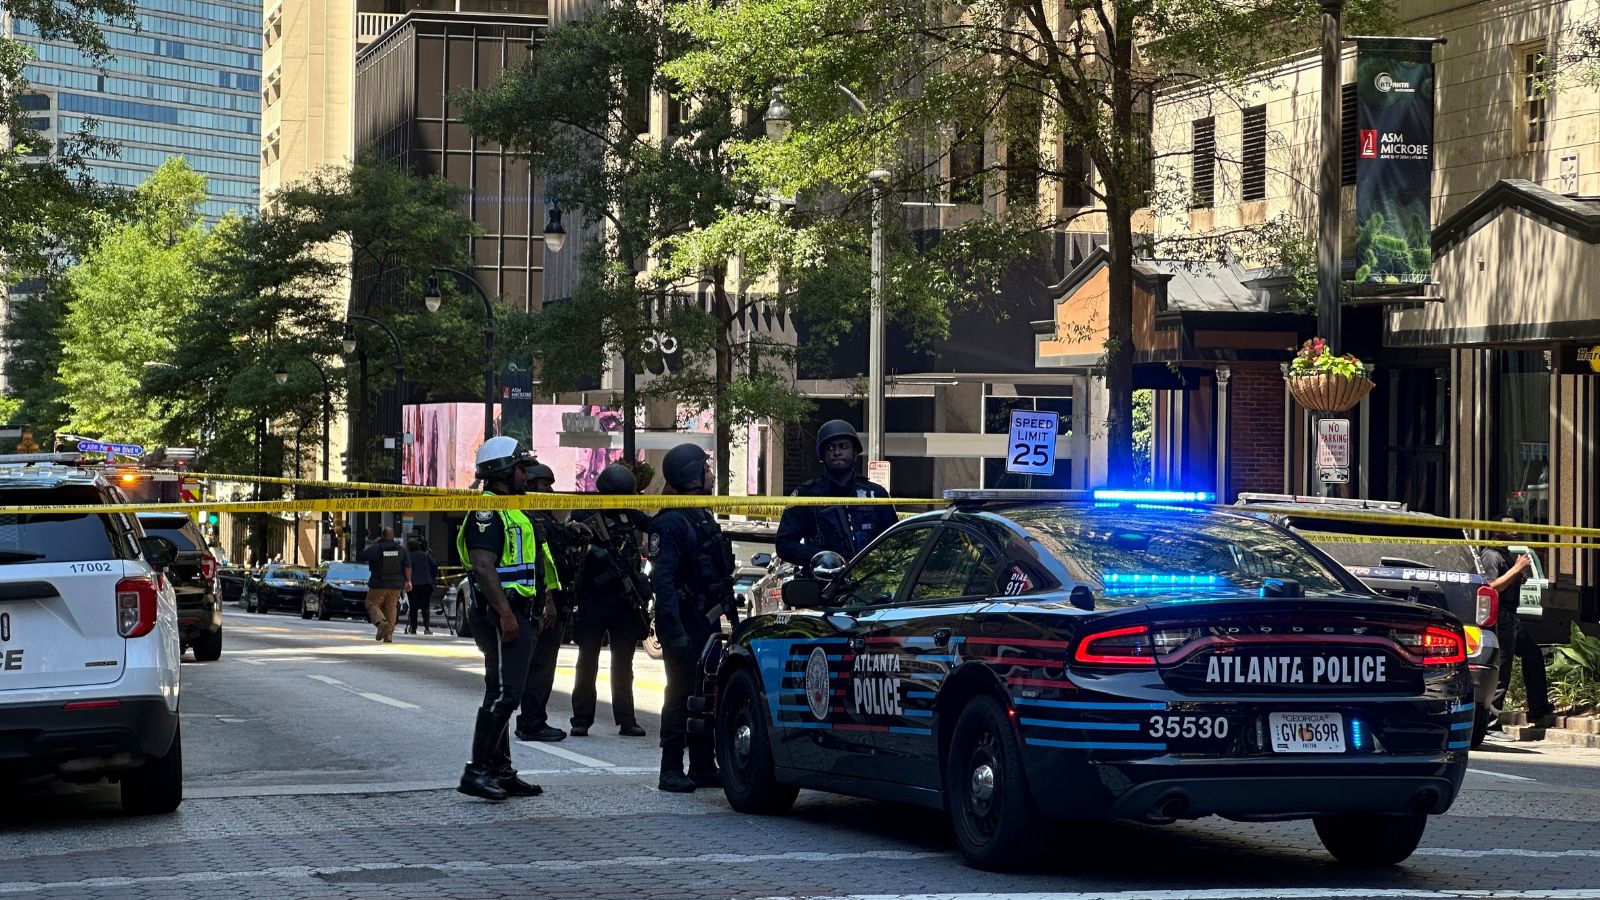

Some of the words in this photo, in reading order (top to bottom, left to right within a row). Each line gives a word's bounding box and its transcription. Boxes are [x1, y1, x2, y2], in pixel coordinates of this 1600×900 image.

[1380, 133, 1403, 142] ASM
[1380, 144, 1428, 154] MICROBE
[1577, 348, 1600, 360] Har
[1015, 418, 1053, 428] SPEED
[1329, 424, 1339, 432] NO
[1018, 431, 1048, 441] LIMIT
[1321, 434, 1346, 442] PARKING
[1013, 443, 1048, 466] 25
[70, 563, 112, 573] 17002
[1011, 573, 1028, 581] DIAL
[1402, 569, 1470, 583] POLICE
[1005, 582, 1024, 595] 911
[0, 649, 24, 670] E
[854, 654, 900, 671] ATLANTA
[1206, 656, 1303, 683] ATLANTA
[1313, 656, 1386, 683] POLICE
[854, 678, 902, 715] POLICE
[1149, 716, 1228, 738] 35530
[1282, 723, 1339, 742] GV1569R
